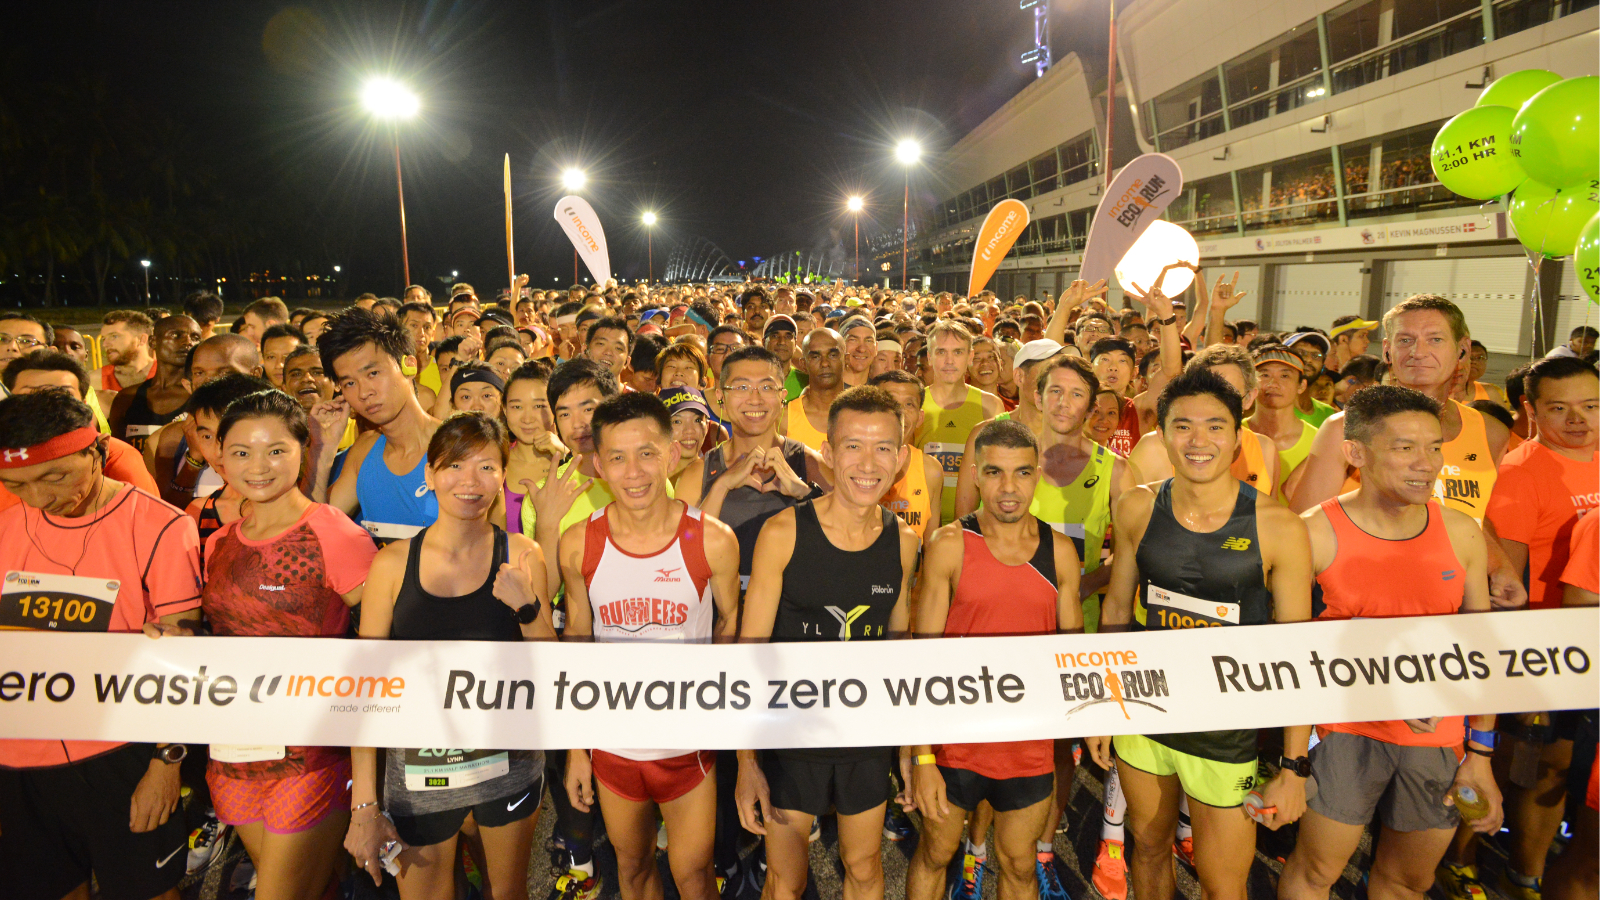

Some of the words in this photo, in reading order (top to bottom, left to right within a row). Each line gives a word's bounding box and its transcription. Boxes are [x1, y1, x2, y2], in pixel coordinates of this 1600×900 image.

[1438, 145, 1462, 162] 21.1
[1468, 135, 1496, 150] KM
[1442, 156, 1468, 172] 2:00
[1473, 148, 1497, 161] HR
[1108, 178, 1144, 218] income
[1116, 203, 1141, 228] ECO
[1139, 174, 1166, 203] RUN
[571, 215, 600, 253] income
[988, 210, 1017, 250] income
[1390, 229, 1411, 238] KEVIN
[1412, 225, 1462, 237] MAGNUSSEN
[131, 437, 148, 450] 11
[1445, 478, 1481, 498] RUN
[19, 595, 97, 623] 13100
[599, 597, 688, 626] RUNNERS
[1157, 609, 1223, 630] 109
[1054, 650, 1138, 668] income
[1211, 655, 1301, 693] Run
[1308, 643, 1491, 687] towards
[1498, 645, 1592, 678] zero
[0, 671, 76, 702] ero
[94, 665, 238, 707] waste
[286, 674, 406, 698] income
[443, 669, 536, 710] Run
[553, 671, 752, 711] towards
[767, 678, 868, 709] zero
[883, 665, 1026, 707] waste
[1060, 672, 1106, 702] ECO
[1120, 669, 1170, 699] RUN
[330, 703, 359, 713] made
[362, 703, 402, 714] different
[446, 755, 464, 764] LYNN
